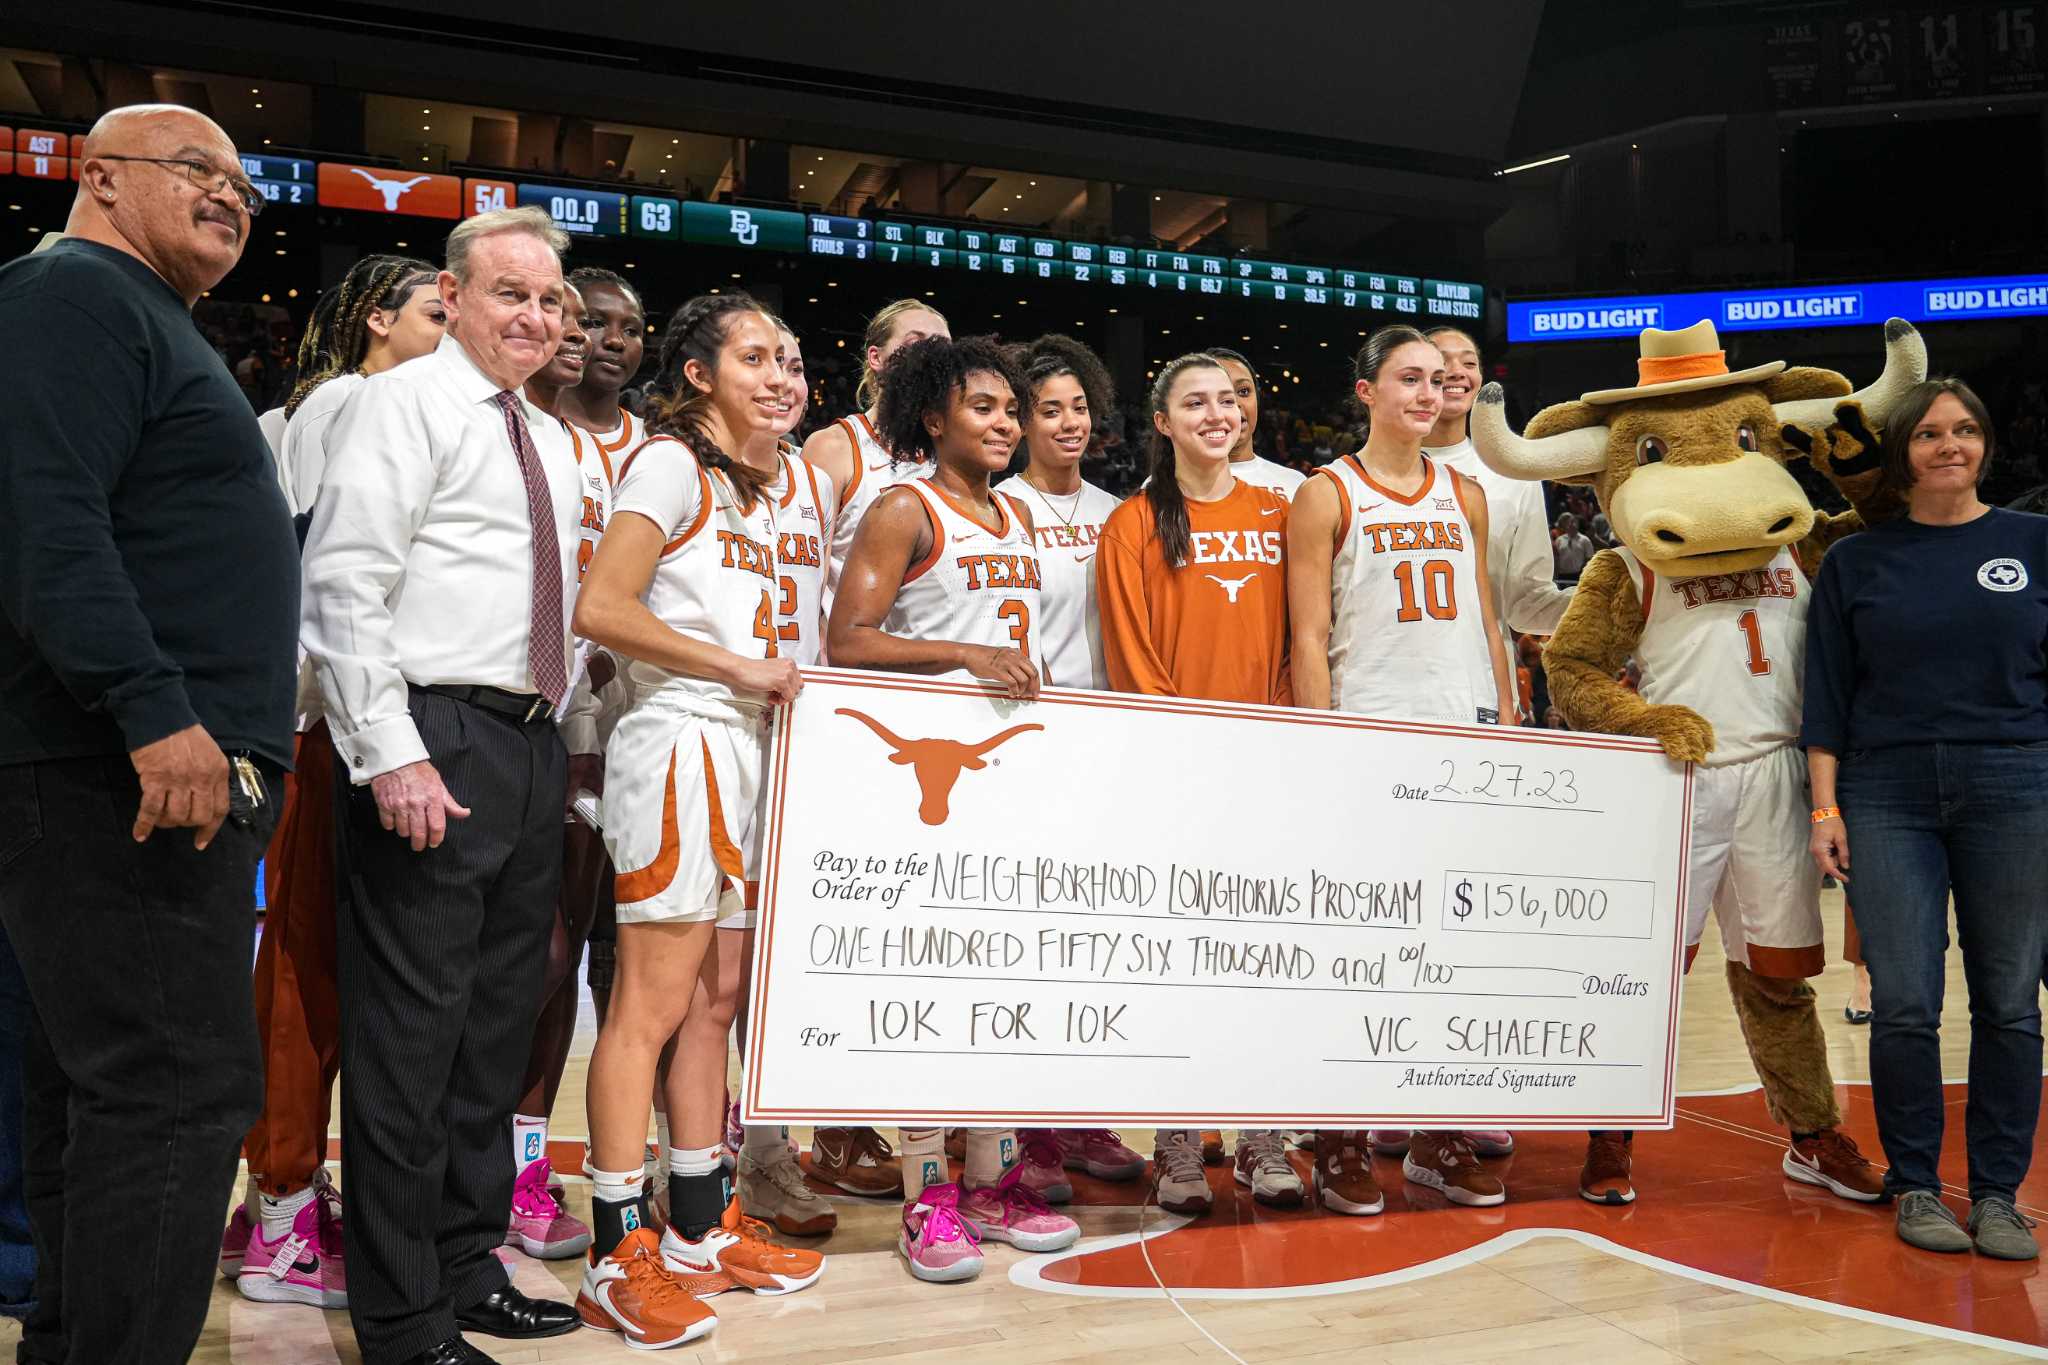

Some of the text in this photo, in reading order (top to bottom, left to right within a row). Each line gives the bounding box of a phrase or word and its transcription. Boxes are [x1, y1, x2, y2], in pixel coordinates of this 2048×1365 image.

[28, 136, 56, 155] AST
[34, 156, 48, 175] 11
[292, 162, 300, 180] 1
[290, 185, 302, 203] 2
[475, 185, 506, 214] 54
[551, 196, 599, 224] 00.0
[641, 202, 671, 232] 63
[812, 218, 867, 238] TOL 3
[885, 226, 903, 241] STL
[925, 230, 944, 246] BLK
[812, 238, 866, 259] FOULS 3
[967, 235, 980, 249] TO
[999, 238, 1017, 253] AST
[890, 247, 899, 262] 7
[931, 251, 940, 266] 3
[968, 255, 981, 270] 12
[1002, 258, 1015, 273] 15
[1147, 254, 1158, 268] FT
[1173, 257, 1189, 271] FTA
[1075, 265, 1089, 281] 22
[1111, 269, 1126, 285] 35
[1148, 273, 1157, 288] 4
[1177, 276, 1186, 290] 6
[1240, 263, 1252, 277] 3P
[1271, 267, 1288, 281] 3PA
[1242, 282, 1250, 297] 5
[1274, 285, 1286, 300] 13
[1344, 274, 1415, 294] FG FGA FG%
[1344, 292, 1356, 307] 27
[1371, 295, 1384, 310] 62
[1427, 298, 1480, 318] TEAM STATS
[1727, 296, 1857, 320] BUD LIGHT
[1929, 287, 2048, 311] BUD LIGH
[1534, 308, 1658, 331] BUD LIGHT
[1035, 523, 1105, 549] TEXA
[1363, 521, 1464, 554] TEXAS
[777, 532, 820, 568] XAS
[1176, 530, 1282, 566] EXAS
[1394, 559, 1457, 622] 10
[1670, 567, 1798, 609] TEXAS
[778, 575, 799, 641] 2
[753, 588, 778, 659] 4
[998, 599, 1030, 659] 3
[1737, 608, 1771, 676] 1
[1392, 783, 1429, 801] Date
[1433, 759, 1579, 804] 2.27.23
[812, 850, 928, 880] Pay to the
[812, 877, 911, 910] Order of
[931, 850, 1157, 911] NEIGHBORHOOD
[1168, 863, 1301, 917] LONGHORNS
[810, 923, 875, 969] ONE
[882, 925, 1024, 968] HUNDRED
[1038, 928, 1122, 978] FIFTY
[1127, 933, 1172, 976] SIX
[1187, 936, 1315, 980] THOUSAND
[1332, 953, 1386, 989] and
[1582, 974, 1649, 997] Dollars
[869, 1000, 1129, 1046] 10K FOR 10K
[799, 1027, 841, 1047] For
[1364, 1015, 1597, 1058] VIC SCHAEFER
[1397, 1066, 1577, 1094] Authorized Signature
